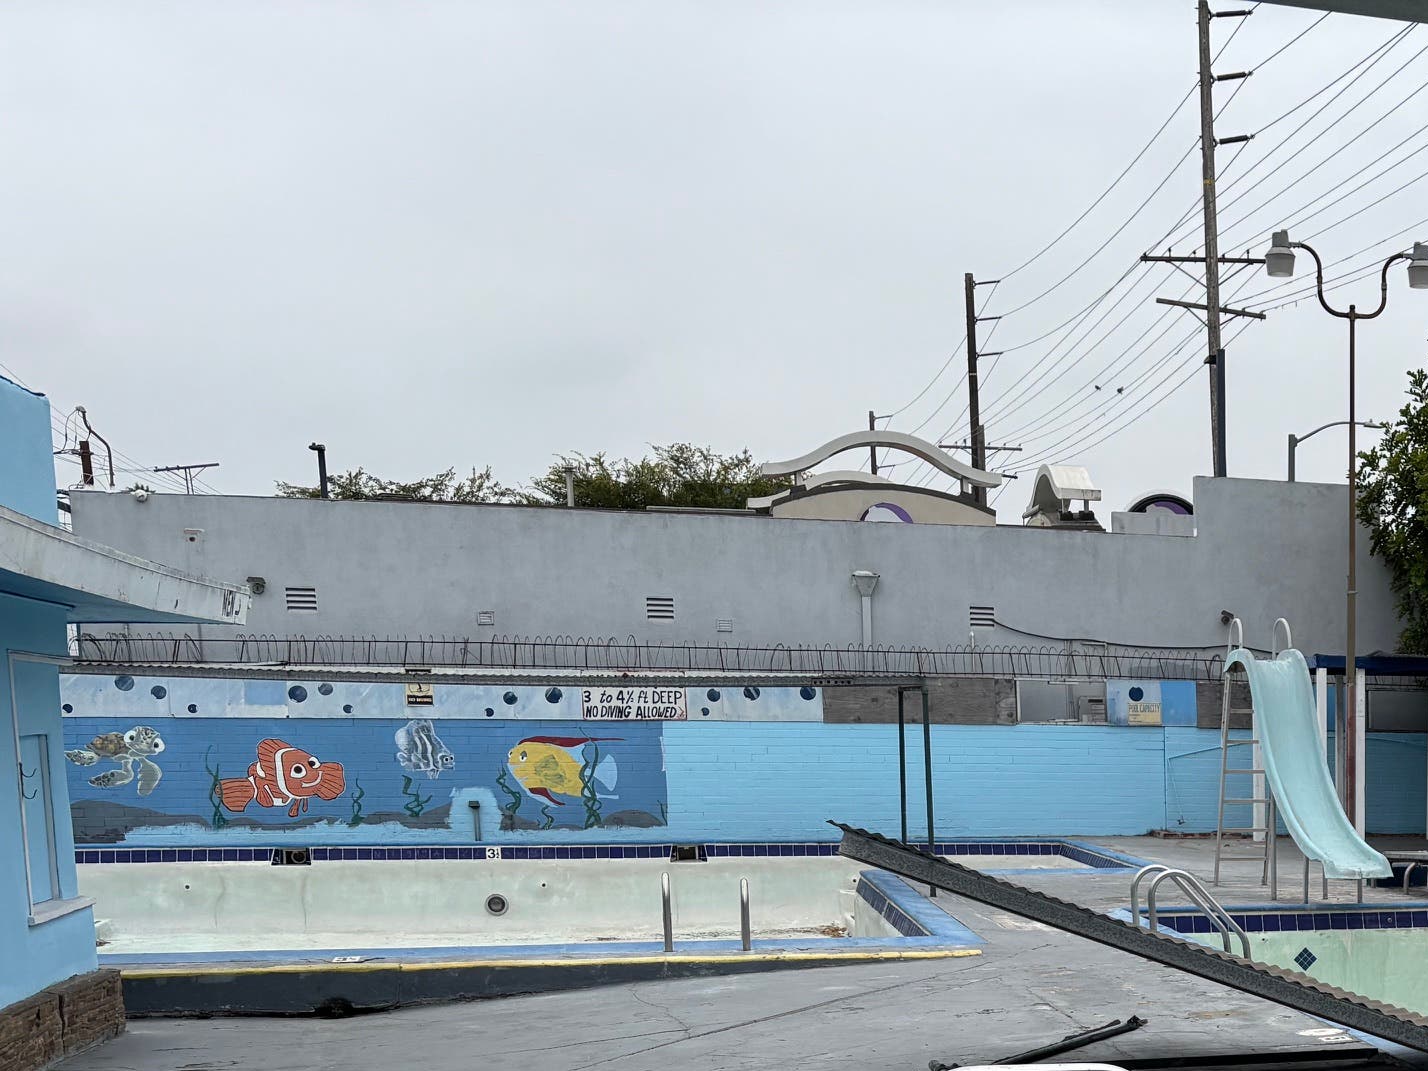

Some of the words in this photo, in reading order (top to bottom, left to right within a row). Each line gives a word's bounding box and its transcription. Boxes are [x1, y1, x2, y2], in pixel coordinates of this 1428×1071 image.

[583, 690, 592, 703] 3
[600, 690, 613, 704] to
[652, 690, 683, 705] DEEP
[585, 705, 599, 718] NO
[601, 705, 632, 718] DIVING
[636, 705, 677, 719] ALLOWED
